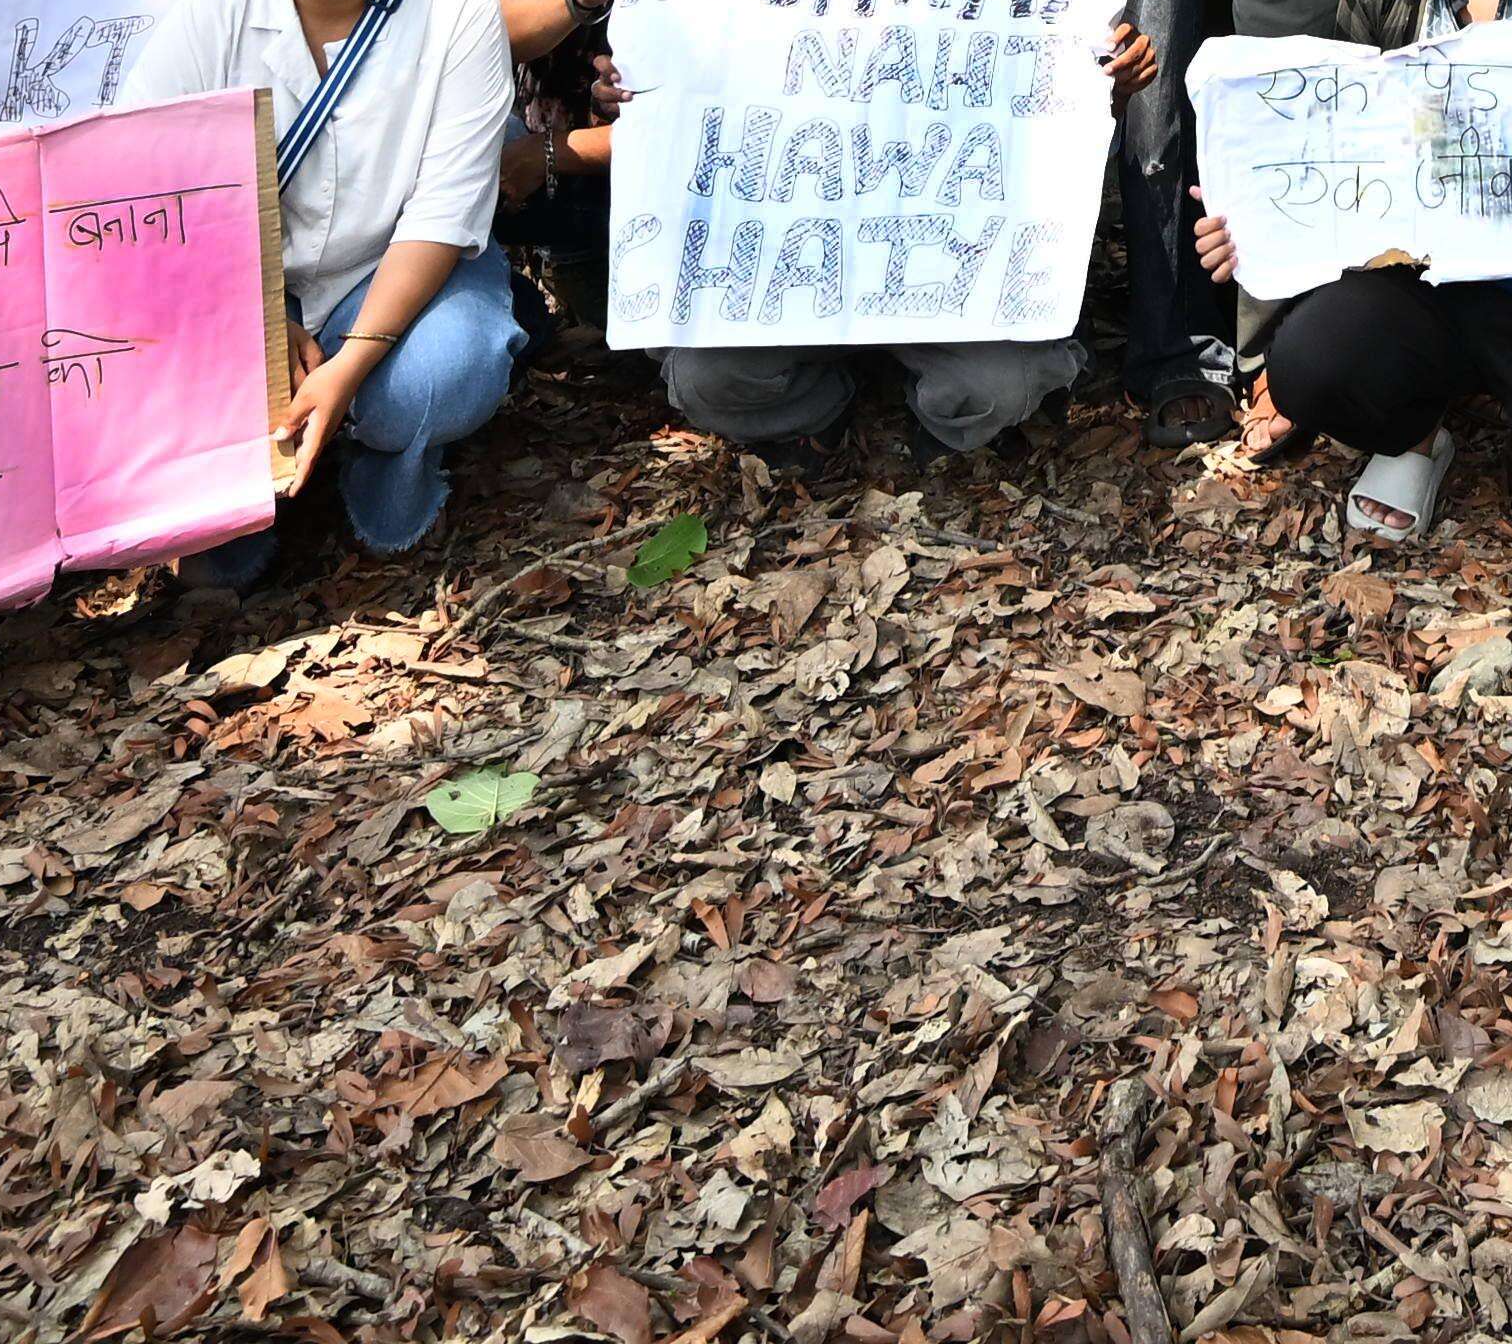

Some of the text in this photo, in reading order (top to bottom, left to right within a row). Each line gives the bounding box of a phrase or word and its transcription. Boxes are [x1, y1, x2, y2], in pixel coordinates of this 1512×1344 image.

[783, 25, 1086, 117] NAHI
[1256, 64, 1370, 120] एक
[688, 105, 1005, 207] HAWA
[49, 184, 243, 250] बनाना
[1252, 160, 1393, 229] एक
[608, 213, 1066, 326] CHAIYE
[41, 330, 136, 399] को
